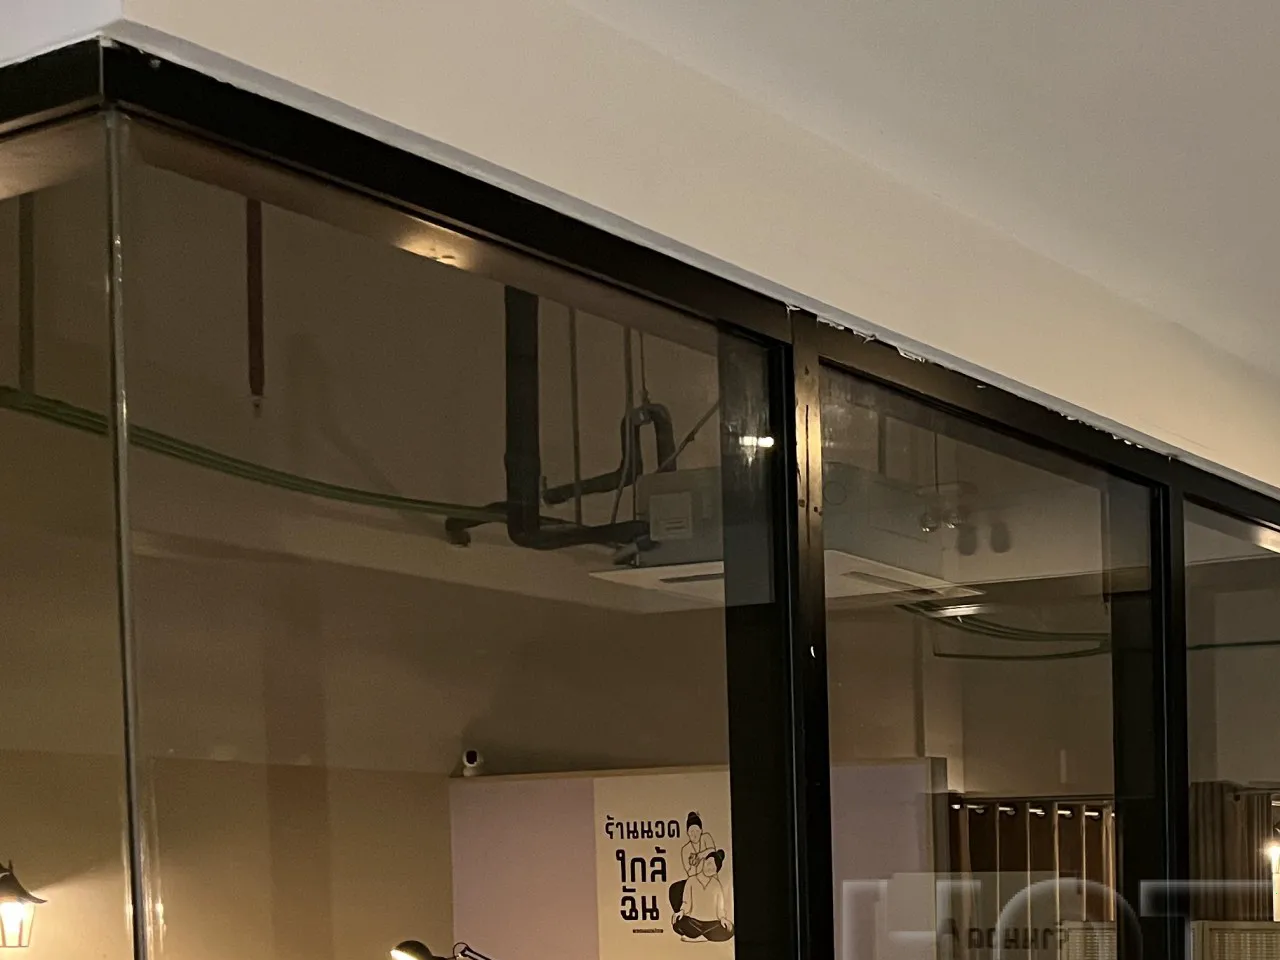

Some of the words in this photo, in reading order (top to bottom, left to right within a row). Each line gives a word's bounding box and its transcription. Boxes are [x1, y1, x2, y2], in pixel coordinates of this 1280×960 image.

[605, 815, 681, 839] ร้านนวด
[615, 847, 667, 883] ใกล้
[620, 885, 660, 921] ฉัน
